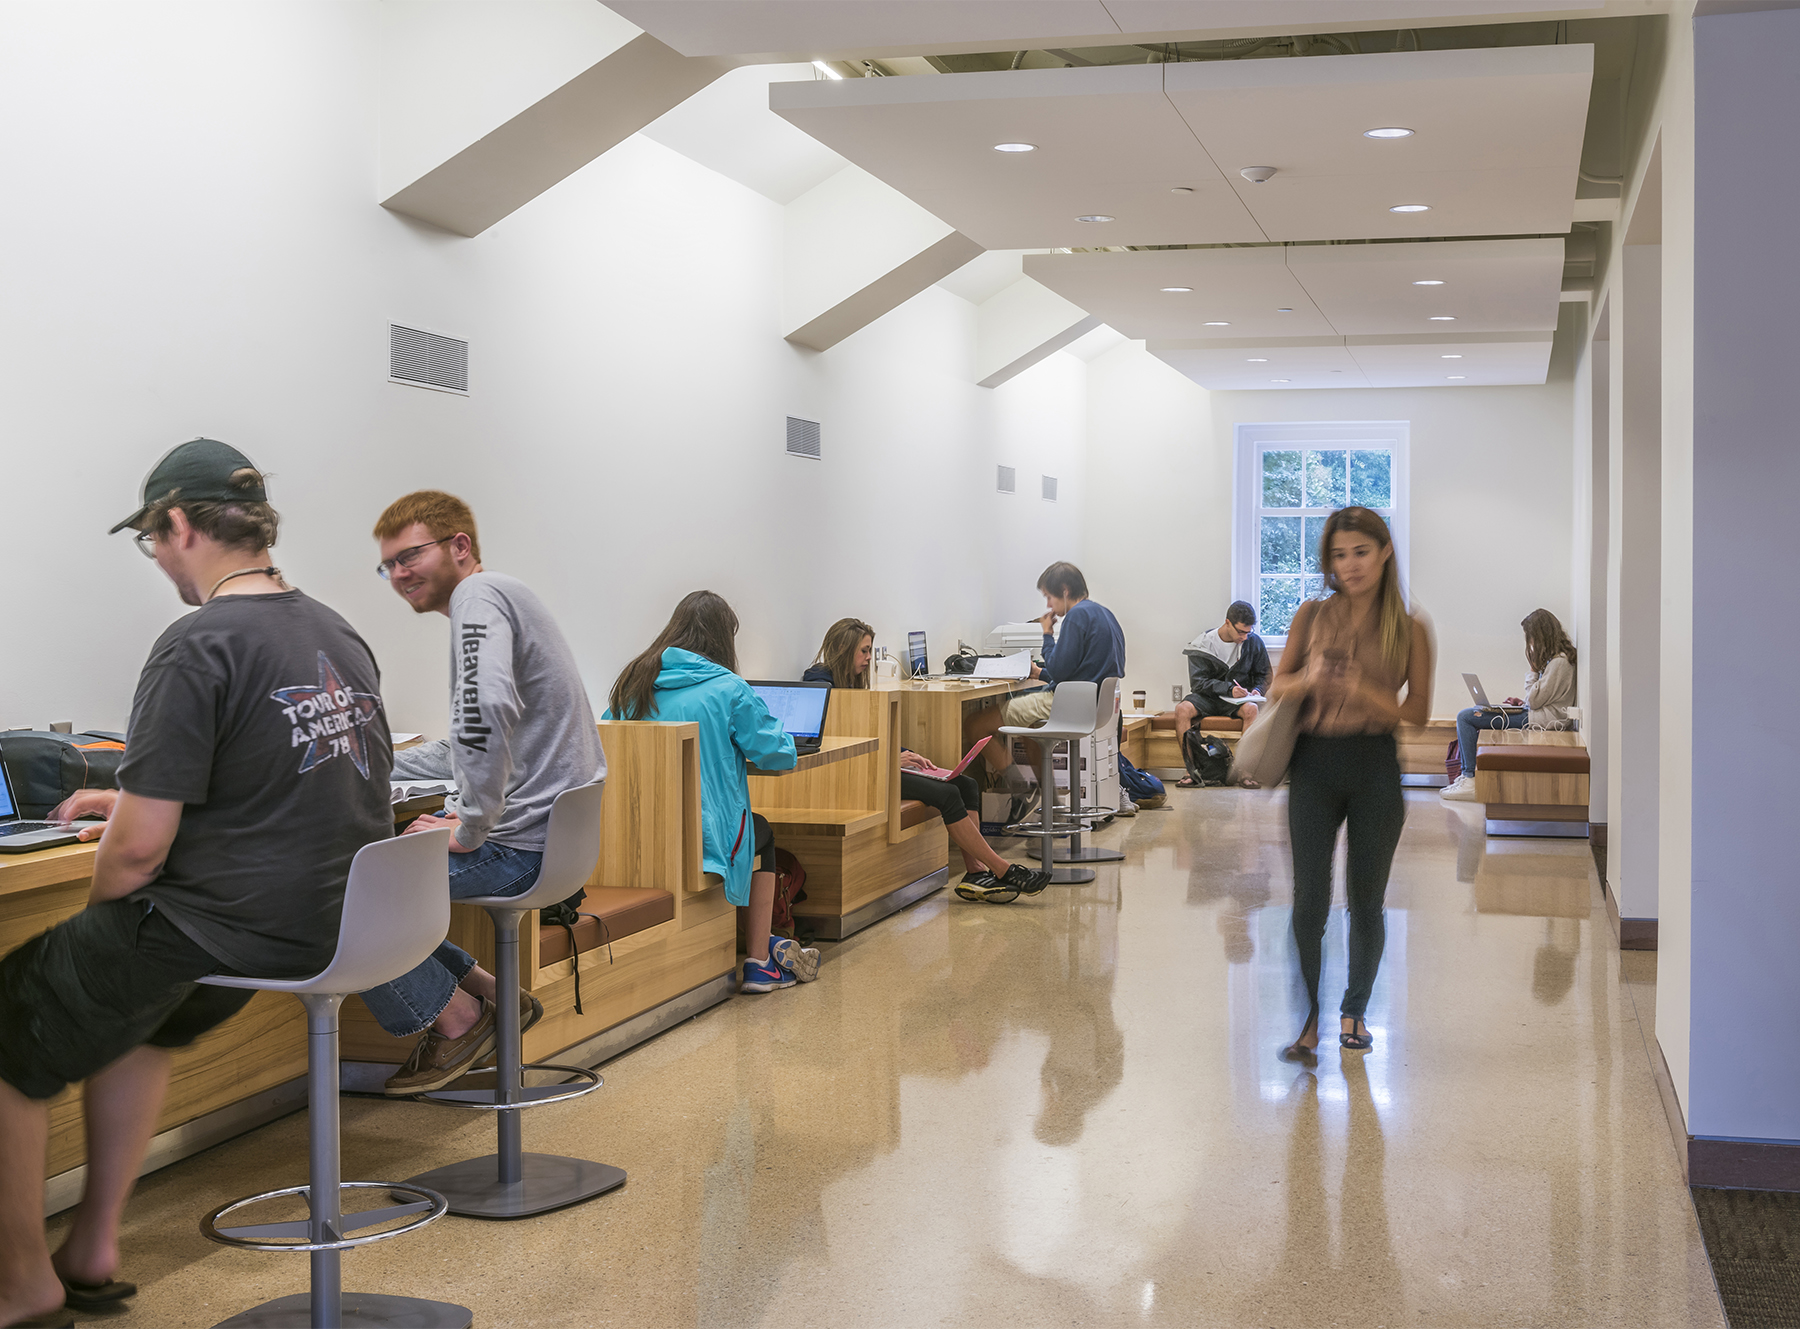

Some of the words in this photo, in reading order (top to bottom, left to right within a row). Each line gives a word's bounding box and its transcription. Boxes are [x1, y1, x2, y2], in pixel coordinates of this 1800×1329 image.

[282, 692, 336, 725] TOUR
[334, 686, 356, 708] OF
[457, 623, 492, 753] Heavenly
[291, 707, 368, 748] AMERICA
[328, 735, 351, 758] 78
